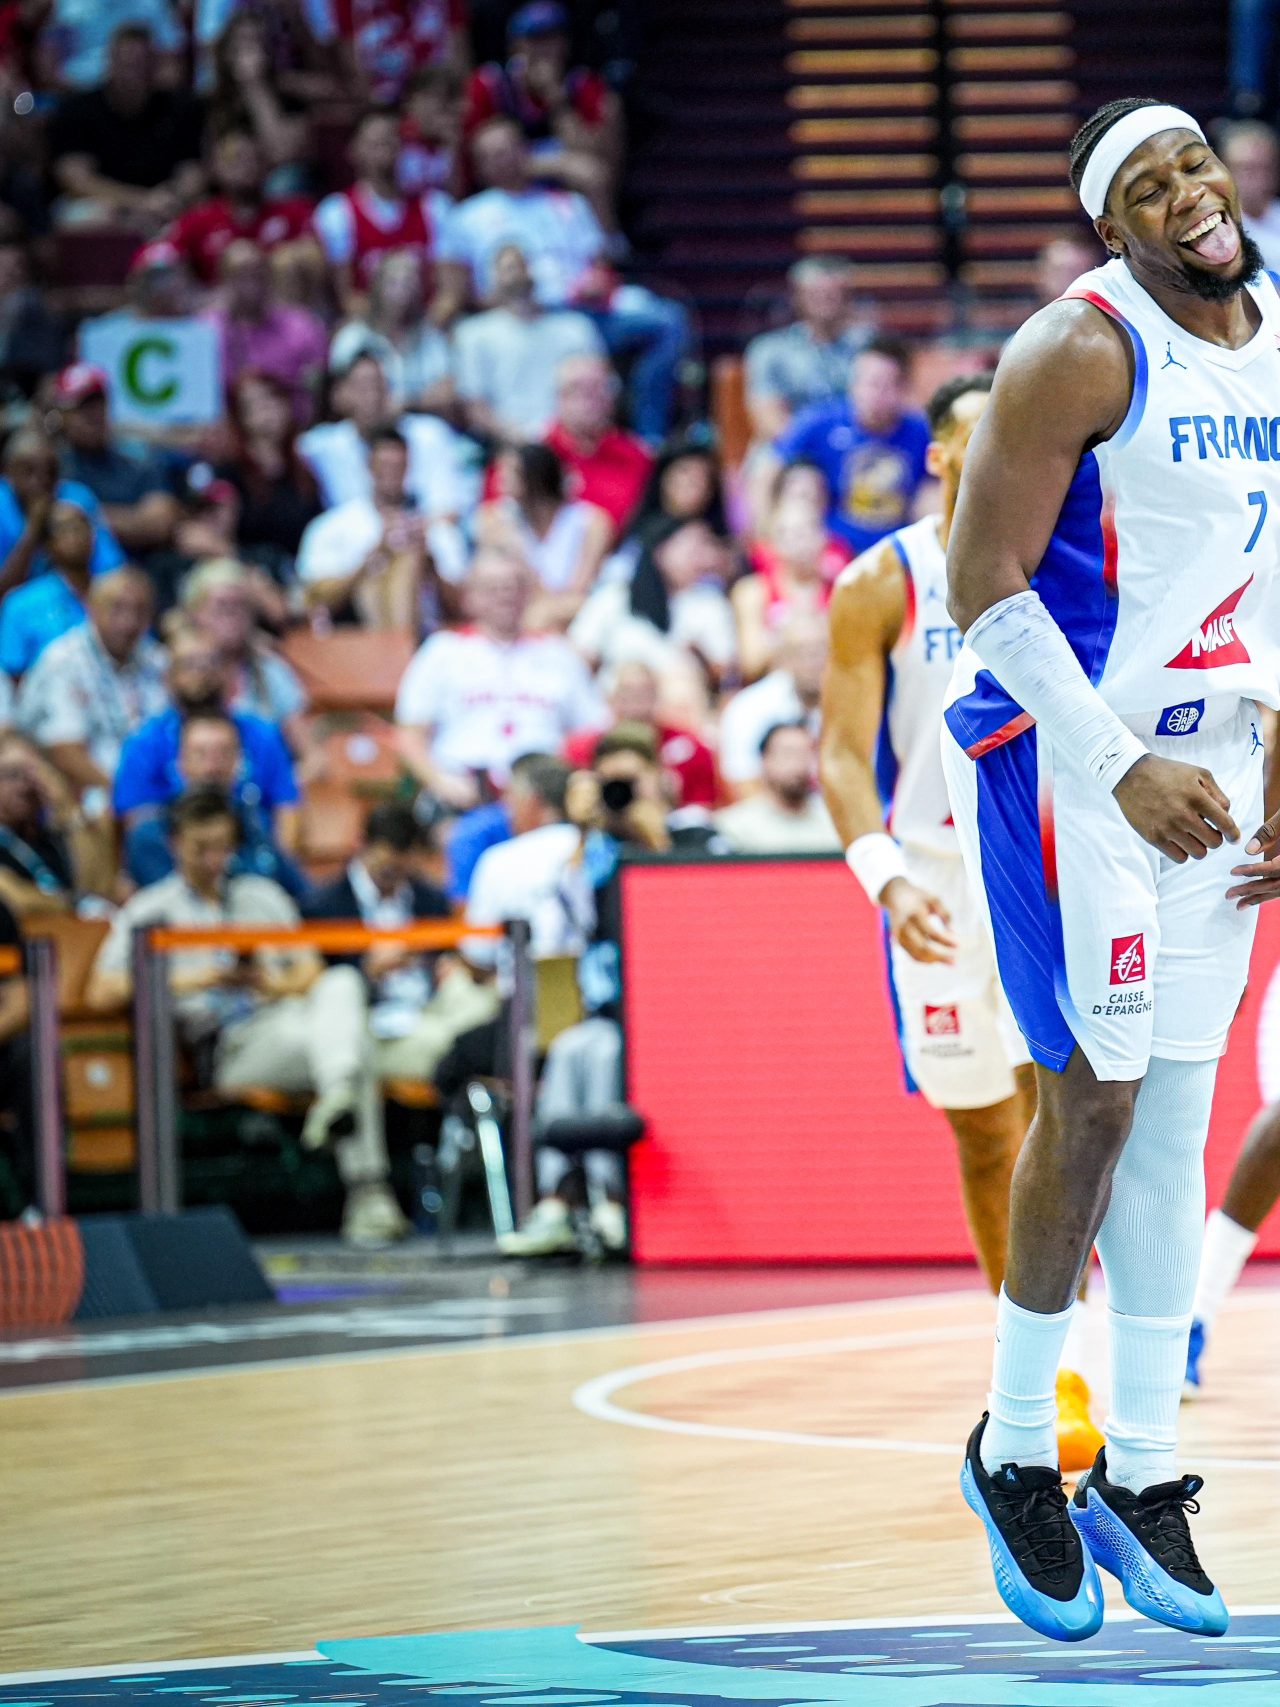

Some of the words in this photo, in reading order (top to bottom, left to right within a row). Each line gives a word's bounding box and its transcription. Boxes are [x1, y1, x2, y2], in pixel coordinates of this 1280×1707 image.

[122, 338, 178, 407] C
[1243, 491, 1267, 553] 7
[1191, 612, 1236, 657] MAIF
[1109, 990, 1144, 1004] CAISSE
